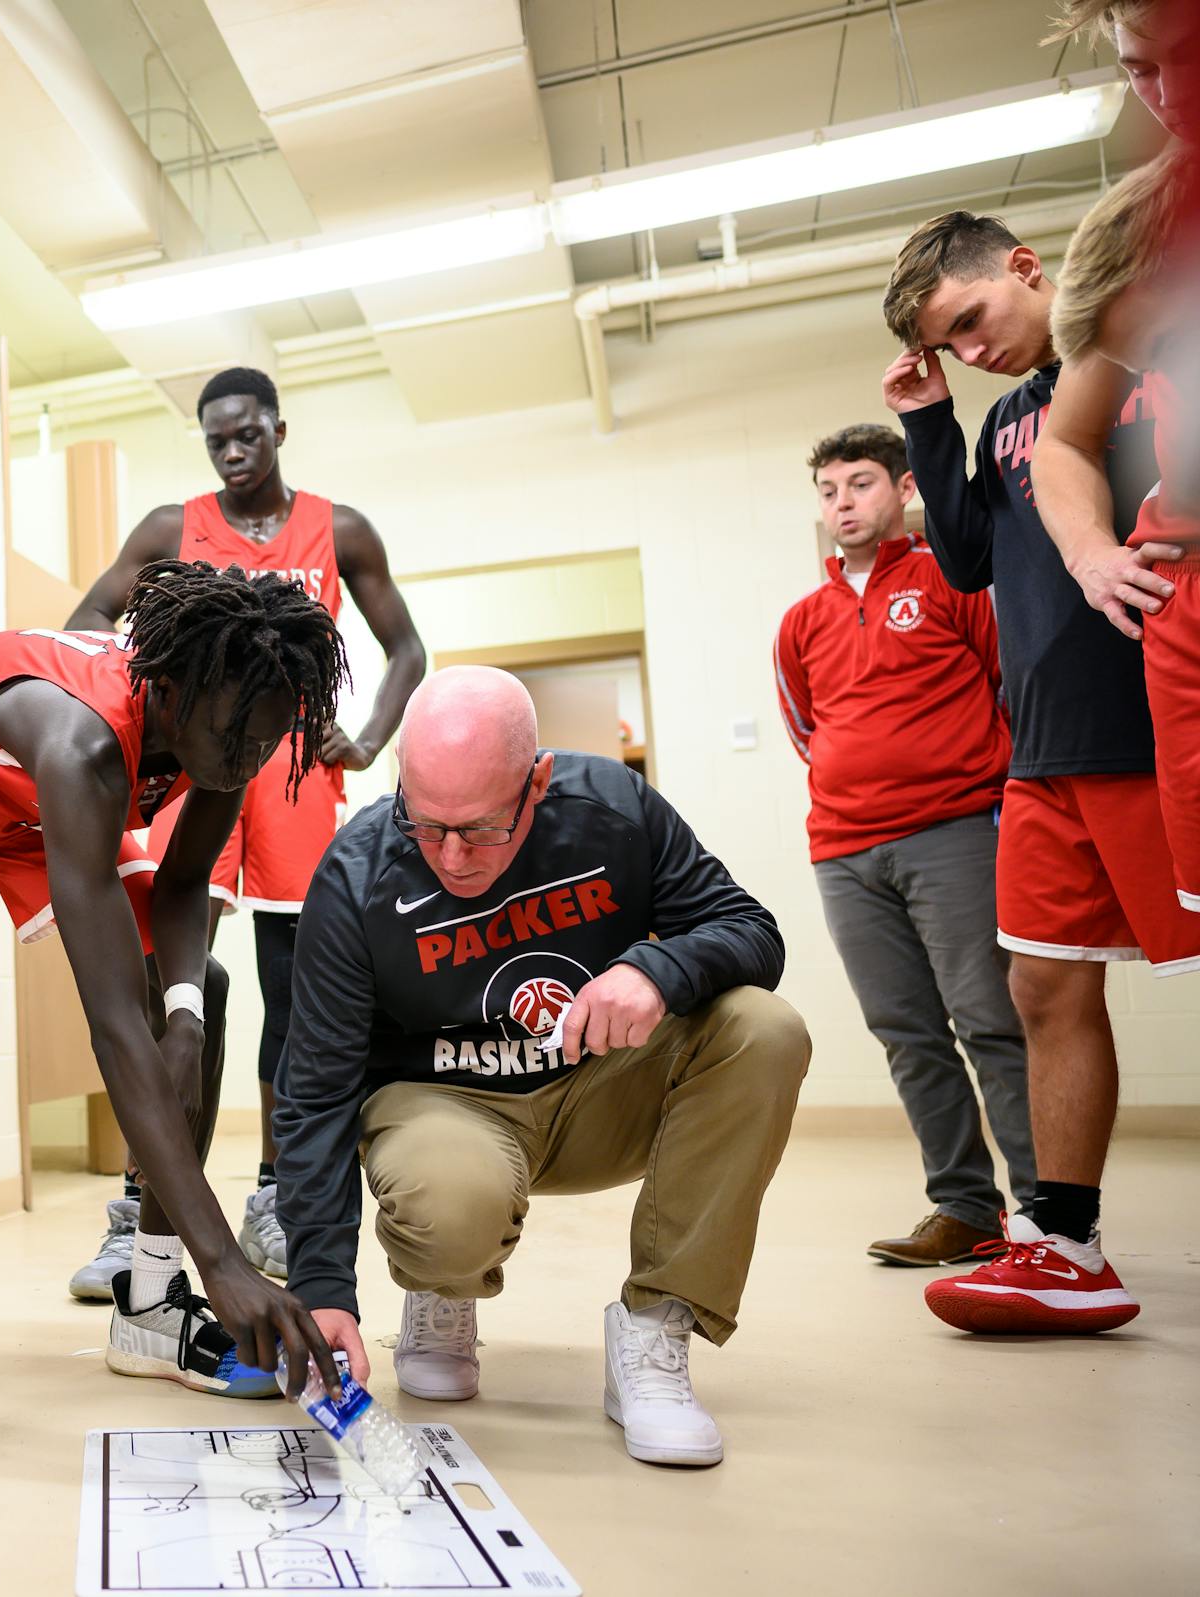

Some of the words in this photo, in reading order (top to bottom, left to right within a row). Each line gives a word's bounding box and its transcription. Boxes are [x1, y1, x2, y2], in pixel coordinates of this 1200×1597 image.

[895, 601, 914, 620] A
[415, 879, 621, 975] PACKER
[533, 1008, 558, 1033] A
[434, 1037, 589, 1076] BASKET
